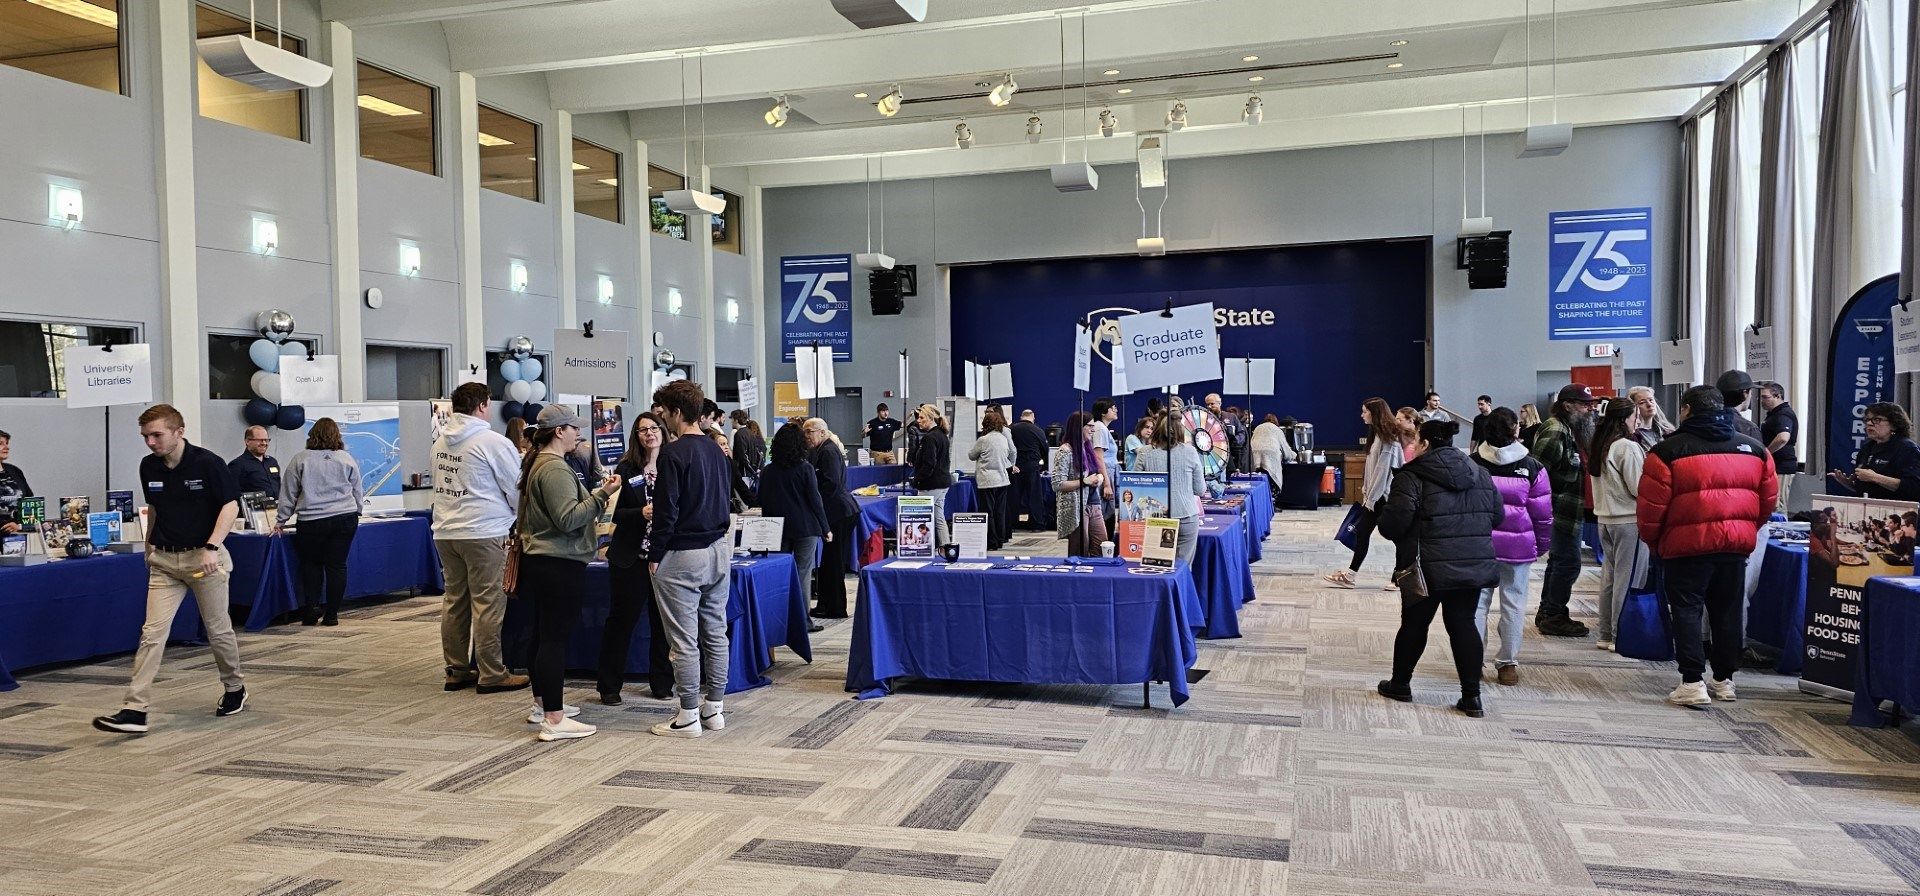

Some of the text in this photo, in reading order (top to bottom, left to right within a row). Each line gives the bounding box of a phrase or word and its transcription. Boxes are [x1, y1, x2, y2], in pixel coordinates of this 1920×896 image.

[1554, 229, 1647, 293] 75
[1600, 267, 1619, 275] 1948
[1626, 266, 1647, 274] 2023
[784, 272, 849, 324] 75
[1555, 301, 1608, 310] CELEBRATING
[1626, 300, 1647, 308] PAST
[1214, 308, 1275, 327] State
[1558, 310, 1594, 318] SHAPING
[1611, 309, 1643, 317] FUTURE
[1133, 329, 1204, 347] Graduate
[1135, 344, 1207, 363] Programs
[1594, 345, 1609, 356] EXIT
[564, 357, 617, 369] Admissions
[83, 364, 134, 374] University
[88, 376, 132, 387] Libraries
[778, 405, 807, 413] Engineering
[1851, 357, 1870, 465] ESPORTS
[436, 452, 463, 463] FOR THE
[438, 463, 459, 474] GLORY
[444, 476, 453, 485] OF
[445, 488, 469, 498] STATE
[21, 508, 45, 518] LIE
[1829, 587, 1862, 602] PENN
[1807, 625, 1840, 641] FOOD
